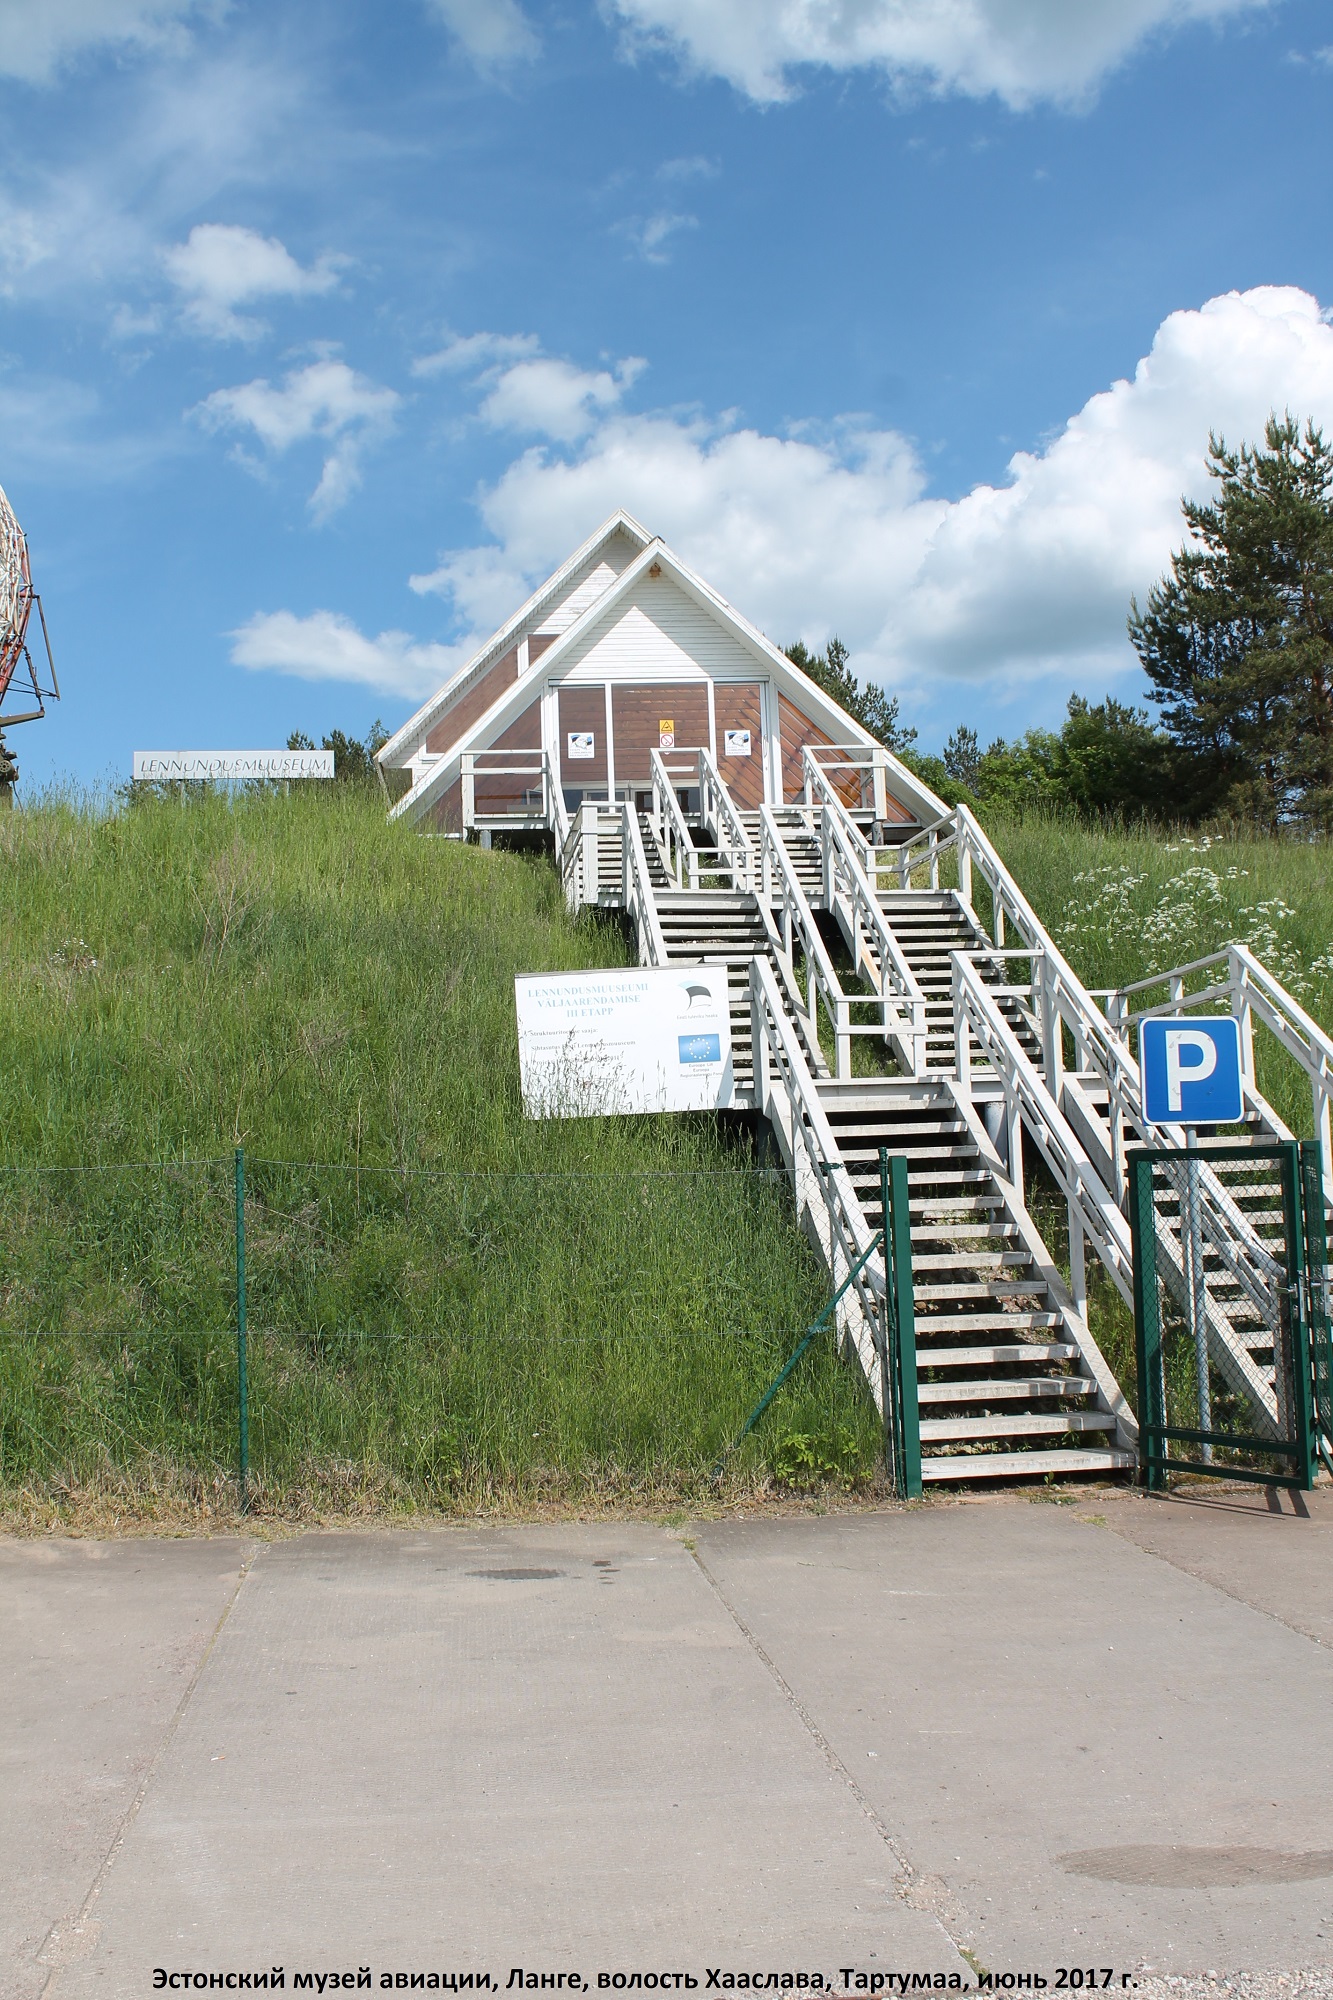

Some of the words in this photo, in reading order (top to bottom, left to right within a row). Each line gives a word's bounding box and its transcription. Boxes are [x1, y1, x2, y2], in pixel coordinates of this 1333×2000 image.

[140, 758, 328, 773] LENNUNDUSMUUSEUM
[528, 983, 649, 998] LENNUNDUSMUUSEUMI
[537, 994, 641, 1008] VÄLJAARENDAMISE
[566, 1009, 578, 1018] III
[581, 1007, 614, 1017] ETAPP
[1165, 1030, 1217, 1112] P
